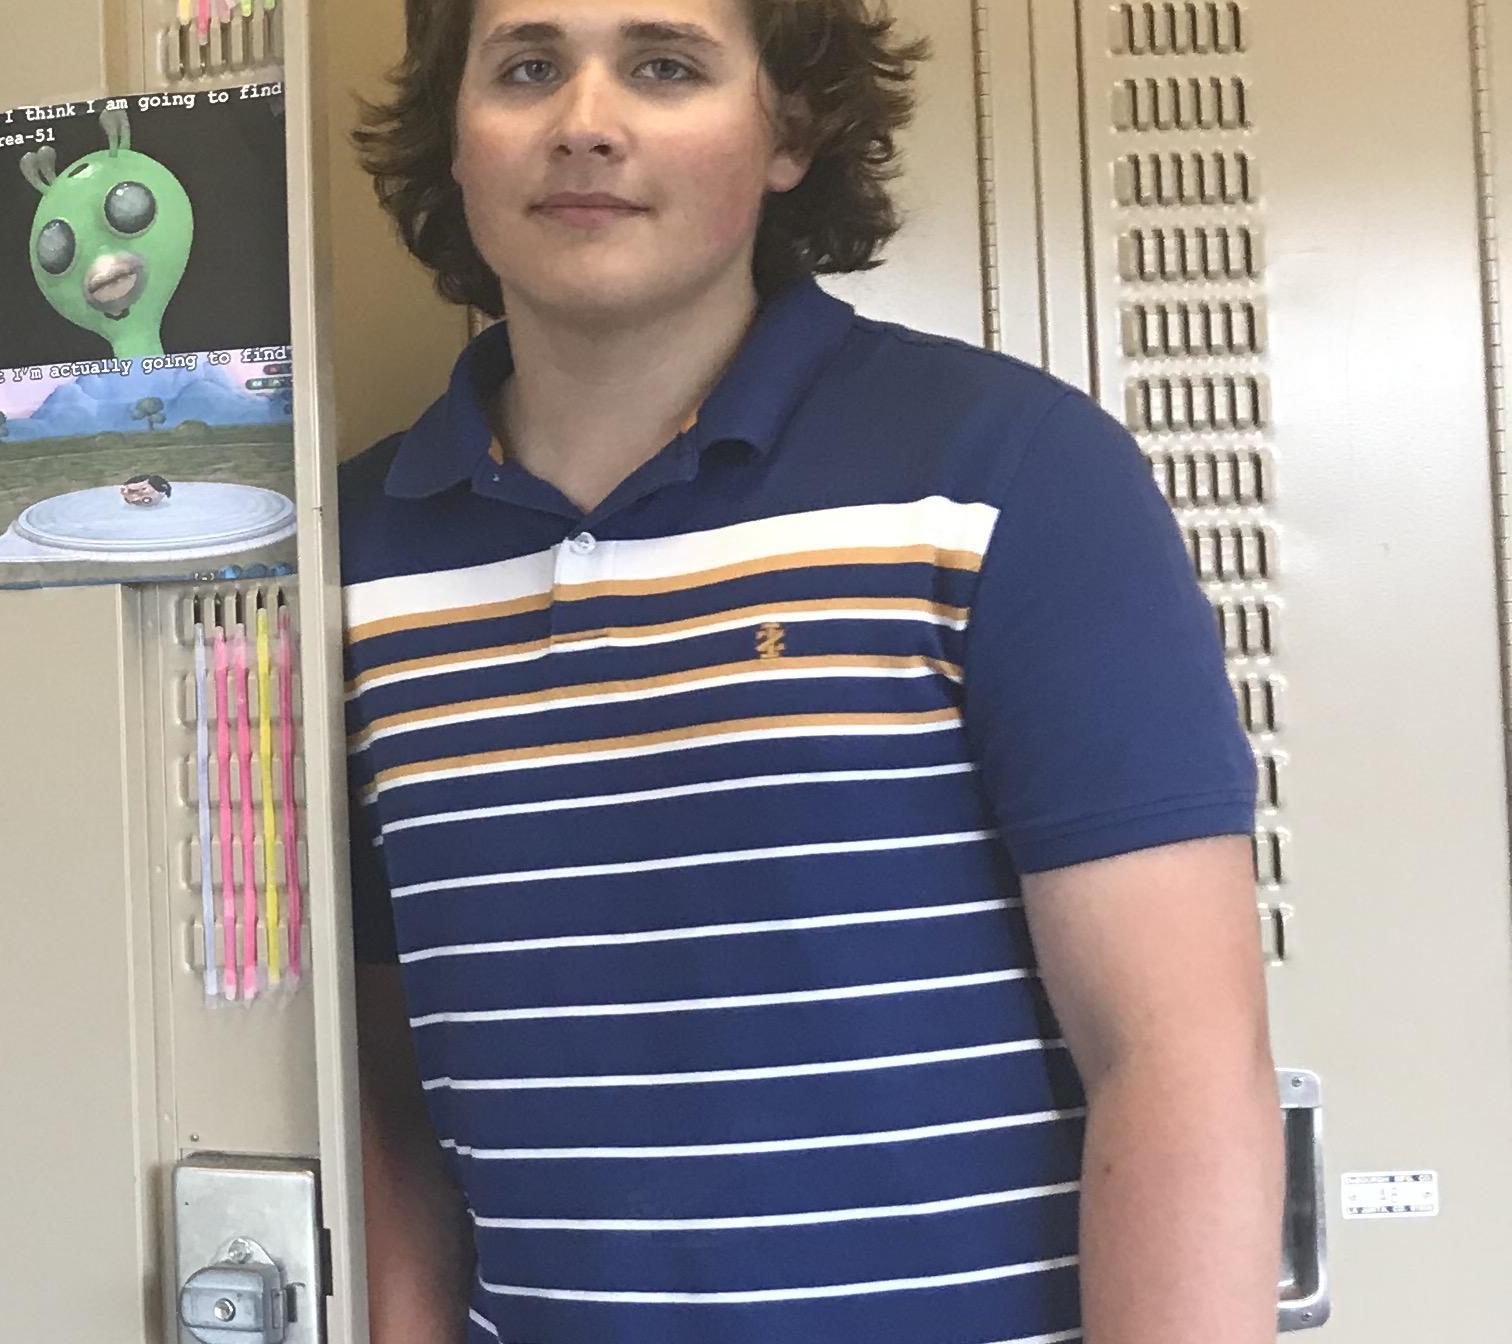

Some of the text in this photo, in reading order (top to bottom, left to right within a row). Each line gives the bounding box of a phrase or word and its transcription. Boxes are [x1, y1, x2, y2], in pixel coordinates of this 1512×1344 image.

[5, 110, 14, 123] I
[25, 103, 76, 121] think
[86, 100, 96, 114] I
[106, 97, 128, 111] am
[138, 92, 195, 111] going
[208, 90, 229, 104] to
[240, 82, 282, 99] find
[50, 358, 132, 377] actually
[142, 354, 197, 373] going
[208, 351, 231, 365] to
[241, 346, 287, 362] find
